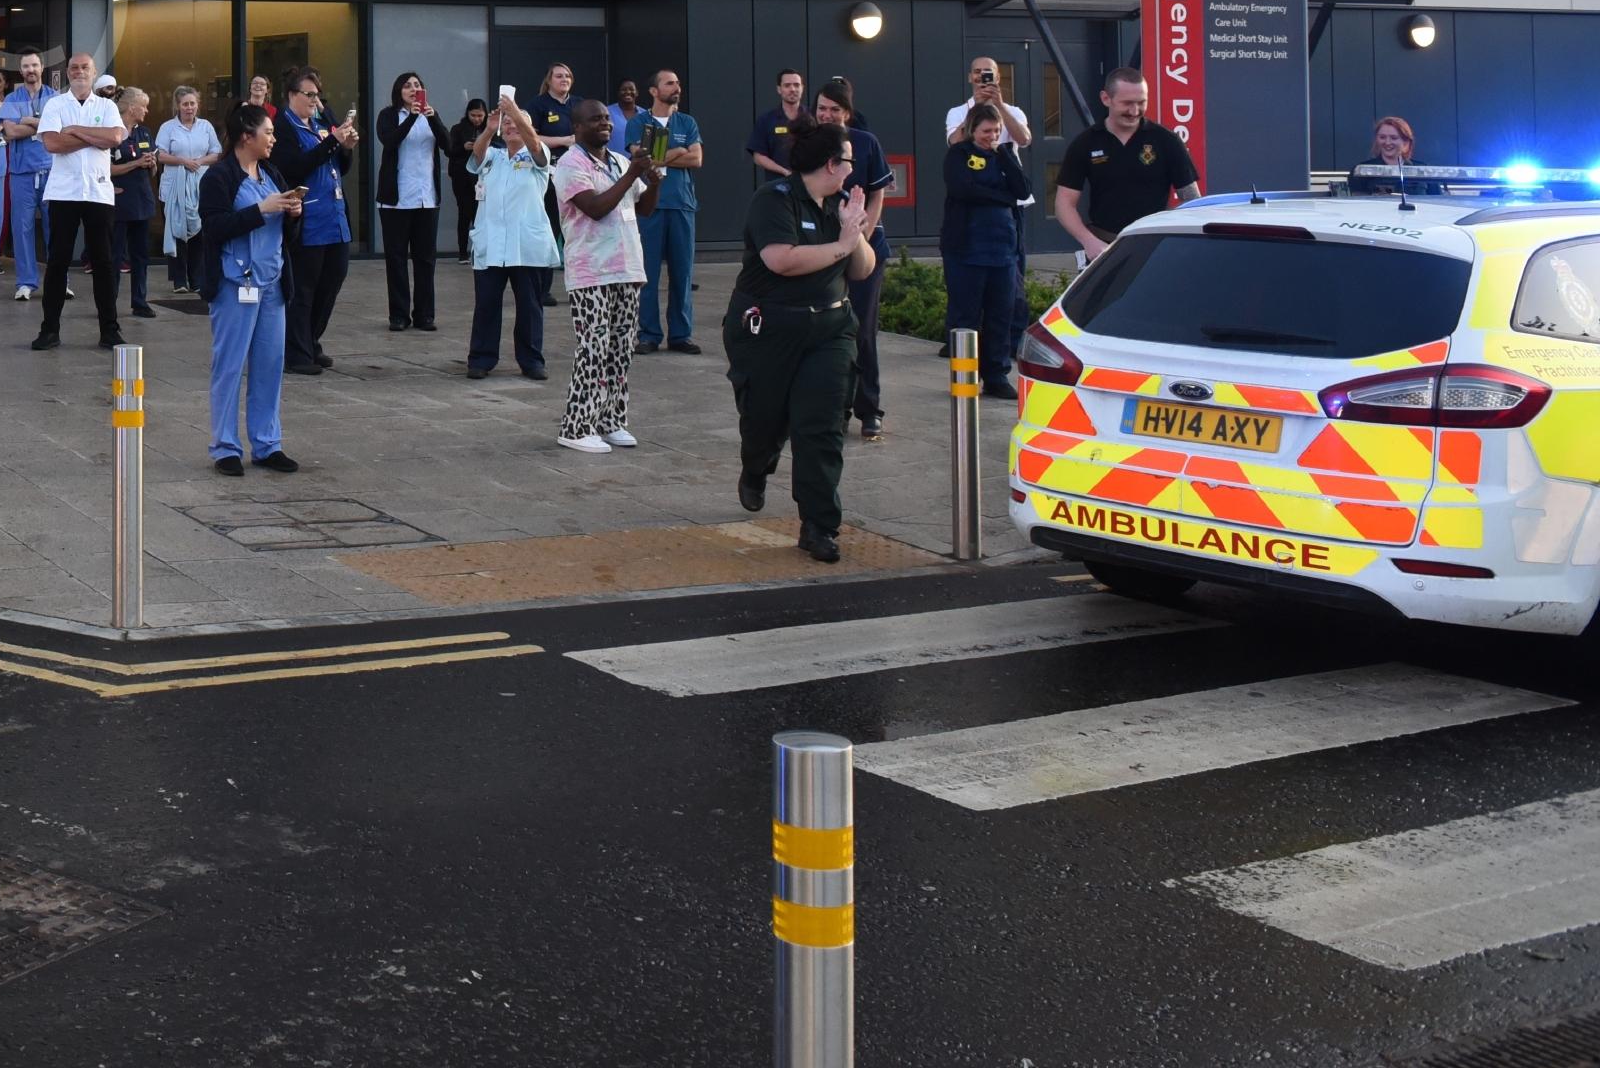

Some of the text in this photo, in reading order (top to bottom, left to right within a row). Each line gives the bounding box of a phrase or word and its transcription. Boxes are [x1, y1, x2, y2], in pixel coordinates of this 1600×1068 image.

[1209, 2, 1287, 14] Ambulatory Emergency
[1215, 18, 1247, 27] Care Unit
[1209, 34, 1288, 44] Medical Short Stay Unit
[1209, 49, 1288, 60] Surgical Short Stay Unit
[1339, 222, 1423, 240] NE202
[1502, 345, 1576, 362] Emergency
[1176, 384, 1202, 397] Ford
[1143, 406, 1271, 446] HV14 AXY
[1050, 500, 1331, 570] AMBULANCE
